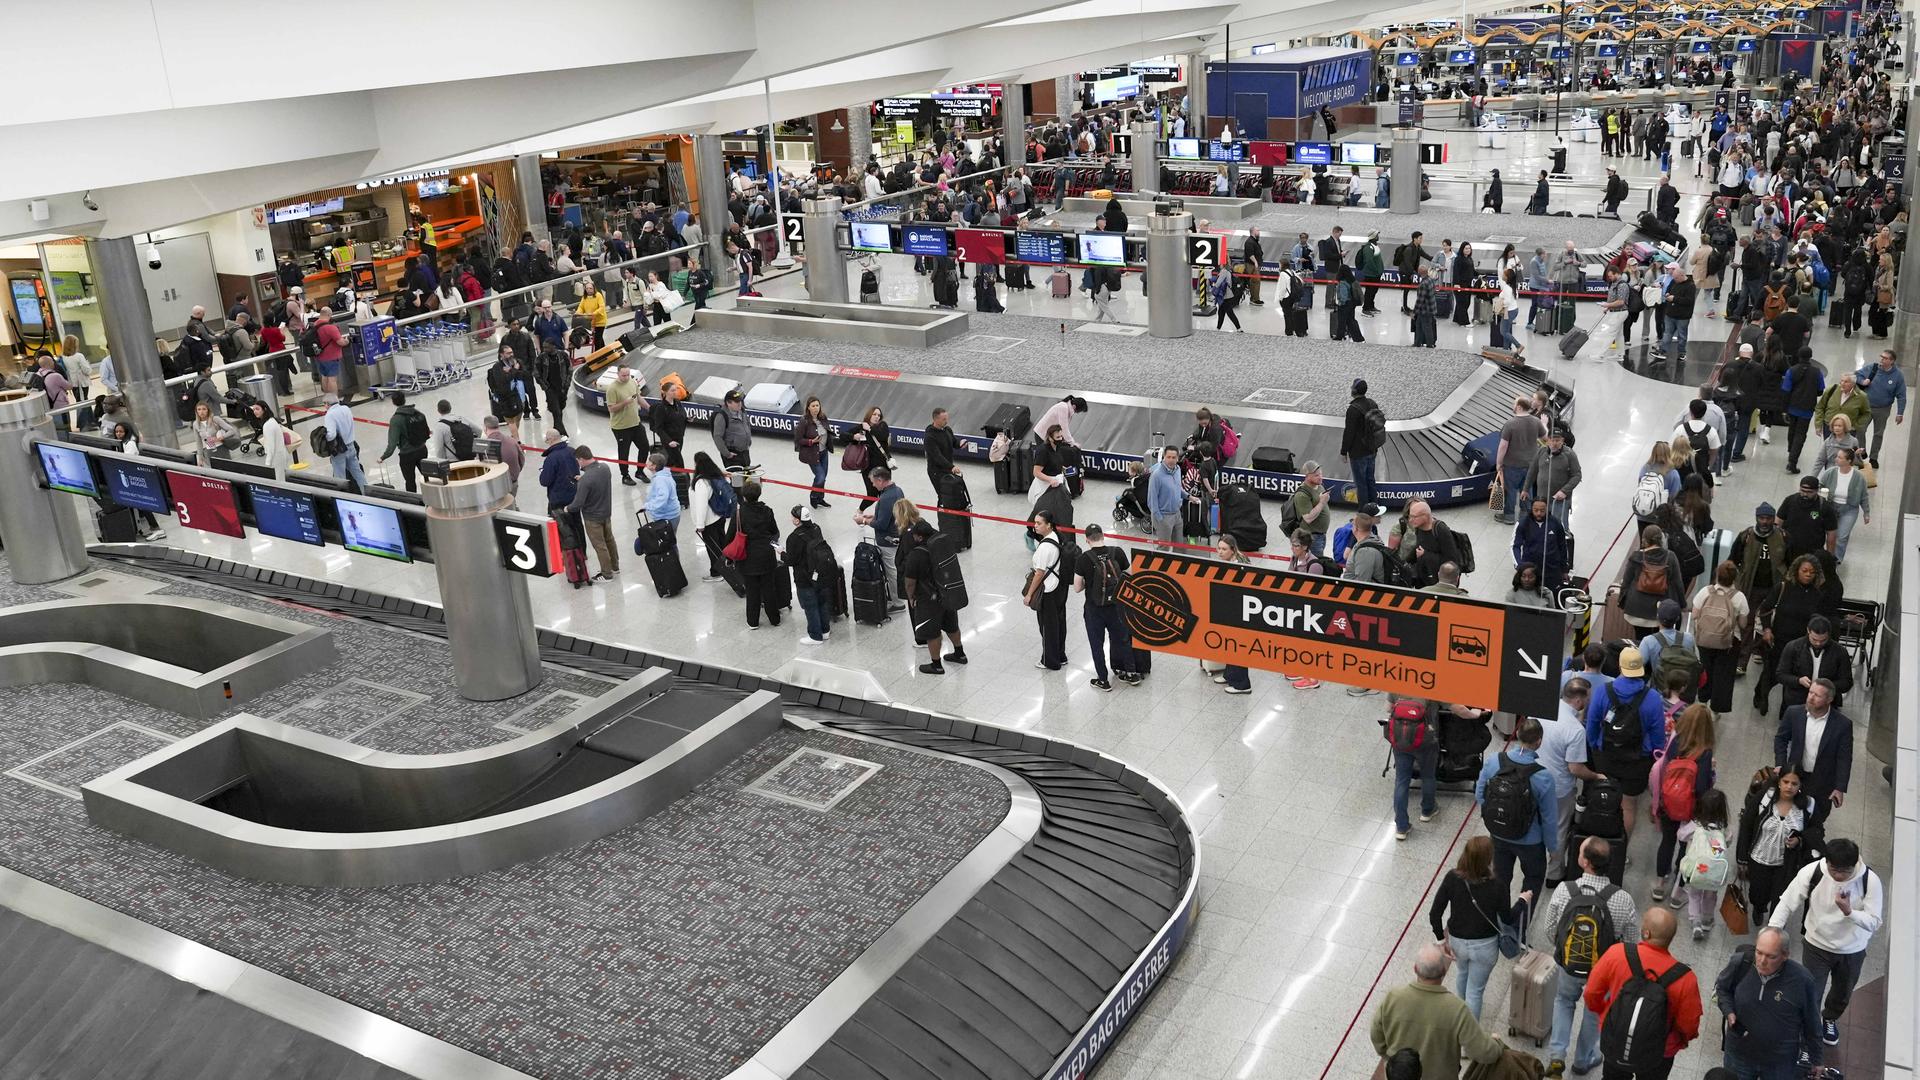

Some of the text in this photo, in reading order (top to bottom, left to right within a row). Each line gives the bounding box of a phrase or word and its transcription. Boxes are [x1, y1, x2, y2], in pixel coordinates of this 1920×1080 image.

[1303, 85, 1355, 108] WELCOME ABOARD
[1119, 136, 1125, 152] 1
[1428, 145, 1435, 163] 1
[1251, 154, 1257, 164] 1
[787, 218, 802, 240] 2
[957, 247, 967, 260] 2
[1195, 240, 1212, 264] 2
[1380, 272, 1396, 283] ATL,
[684, 406, 709, 421] YOUR
[747, 415, 772, 429] CKED
[773, 419, 792, 431] BAG
[206, 482, 224, 490] DELTA
[1221, 472, 1245, 484] BAG
[1248, 475, 1278, 491] FLIES
[1280, 479, 1302, 493] FRE
[177, 501, 190, 524] 3
[505, 525, 537, 570] 3
[1122, 586, 1186, 630] DETOUR
[1242, 594, 1401, 647] ParkATL
[1204, 630, 1436, 690] On-Airport Parking
[1057, 1047, 1088, 1080] KED
[1089, 1011, 1114, 1060] BAG
[1115, 972, 1144, 1026] FLIES
